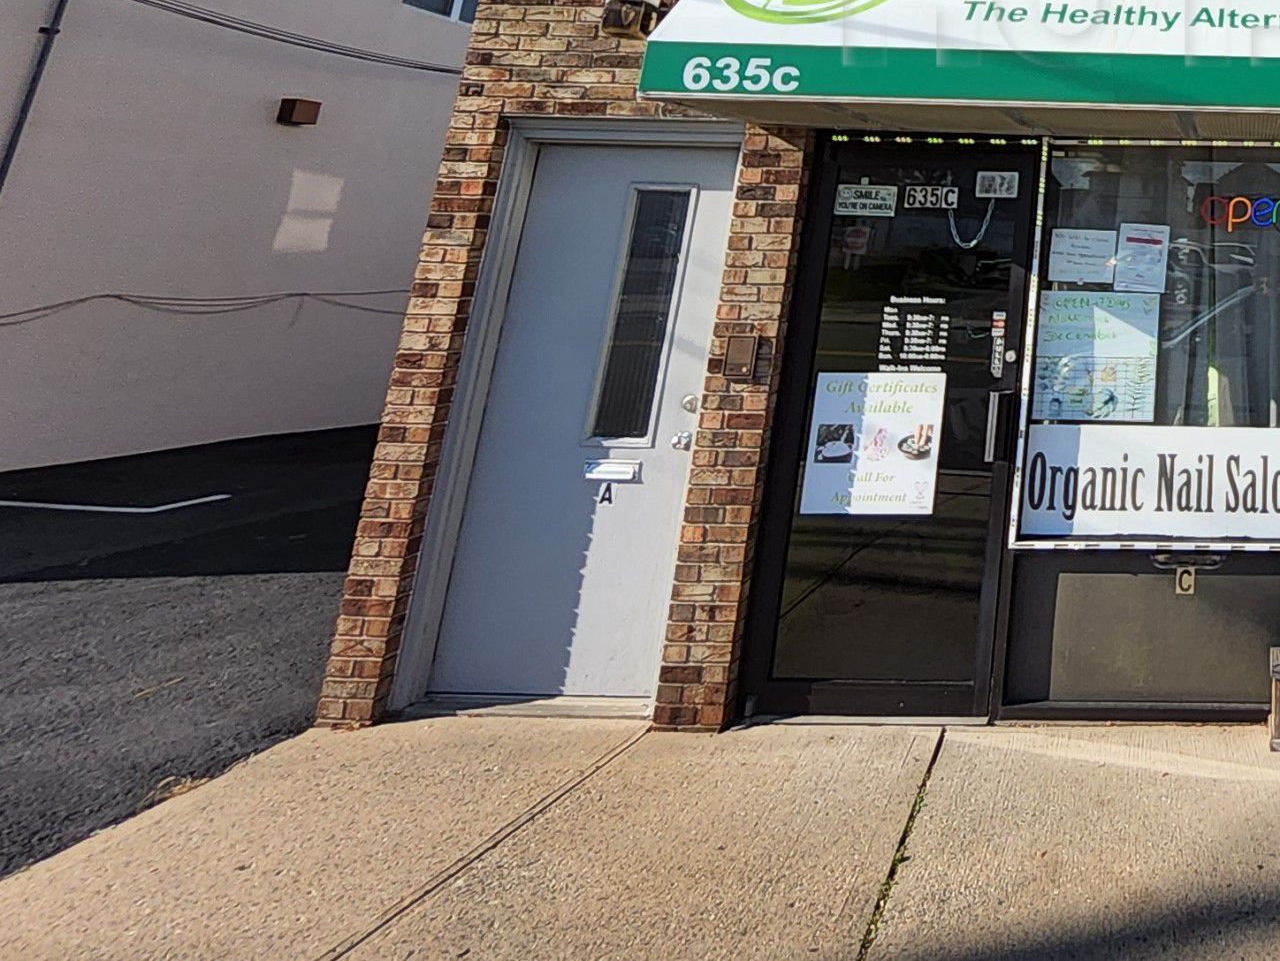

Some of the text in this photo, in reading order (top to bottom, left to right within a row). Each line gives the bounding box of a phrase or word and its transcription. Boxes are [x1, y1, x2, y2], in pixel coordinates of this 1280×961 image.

[962, 0, 1028, 24] The
[1040, 2, 1181, 32] Healthy
[681, 56, 801, 93] 635c
[853, 189, 880, 201] SMILE
[826, 381, 854, 396] Gift
[874, 472, 896, 483] For
[1027, 451, 1145, 520] Organic
[1154, 452, 1215, 514] Nail
[598, 482, 613, 505] A
[831, 491, 907, 505] Appointment
[1178, 568, 1192, 592] C
